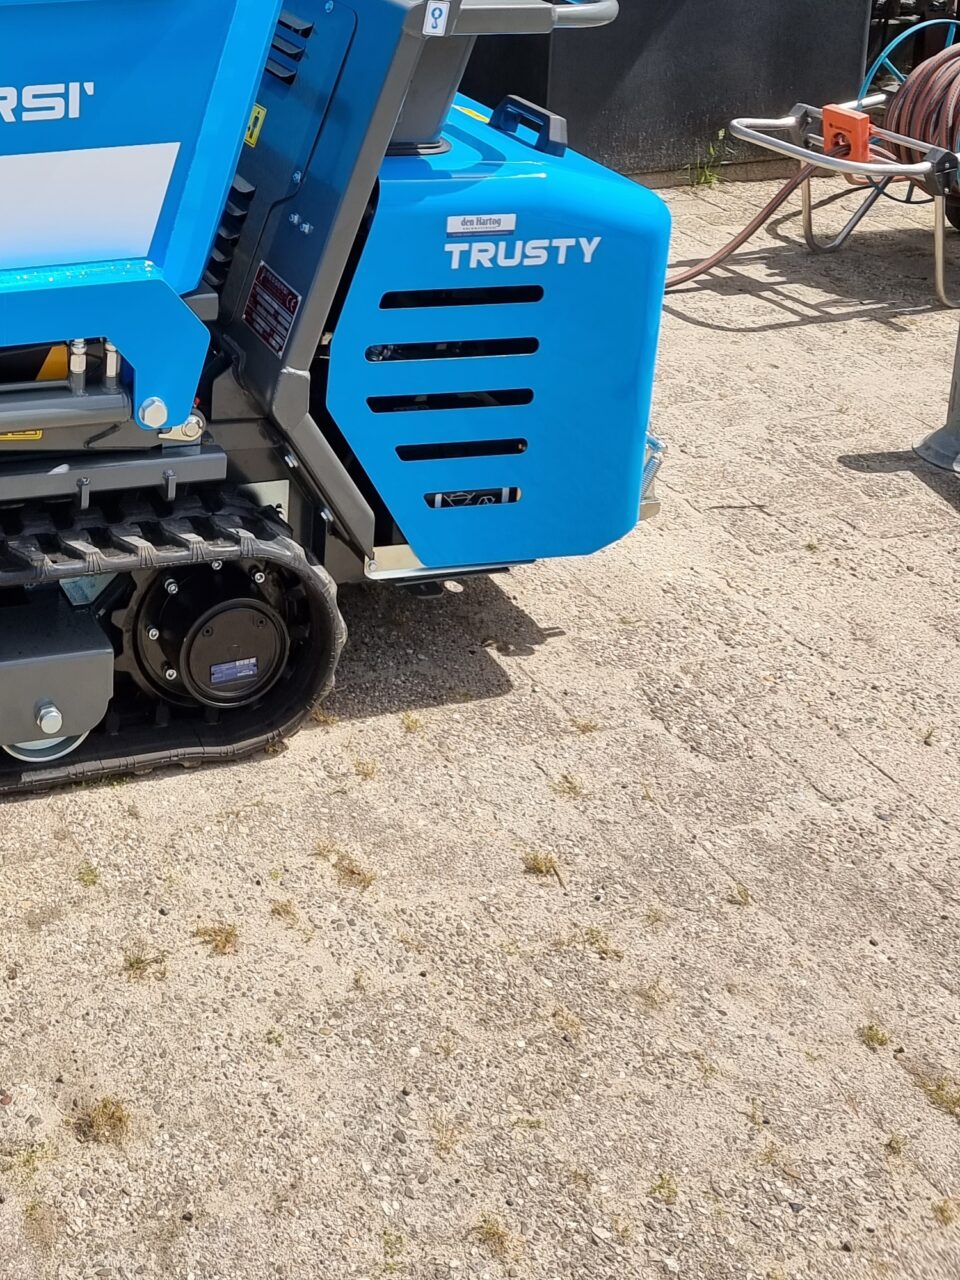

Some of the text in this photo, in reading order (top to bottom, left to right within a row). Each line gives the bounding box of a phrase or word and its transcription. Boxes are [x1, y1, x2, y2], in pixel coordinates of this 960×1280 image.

[461, 217, 502, 228] den Hartog
[444, 237, 602, 269] TRUSTY
